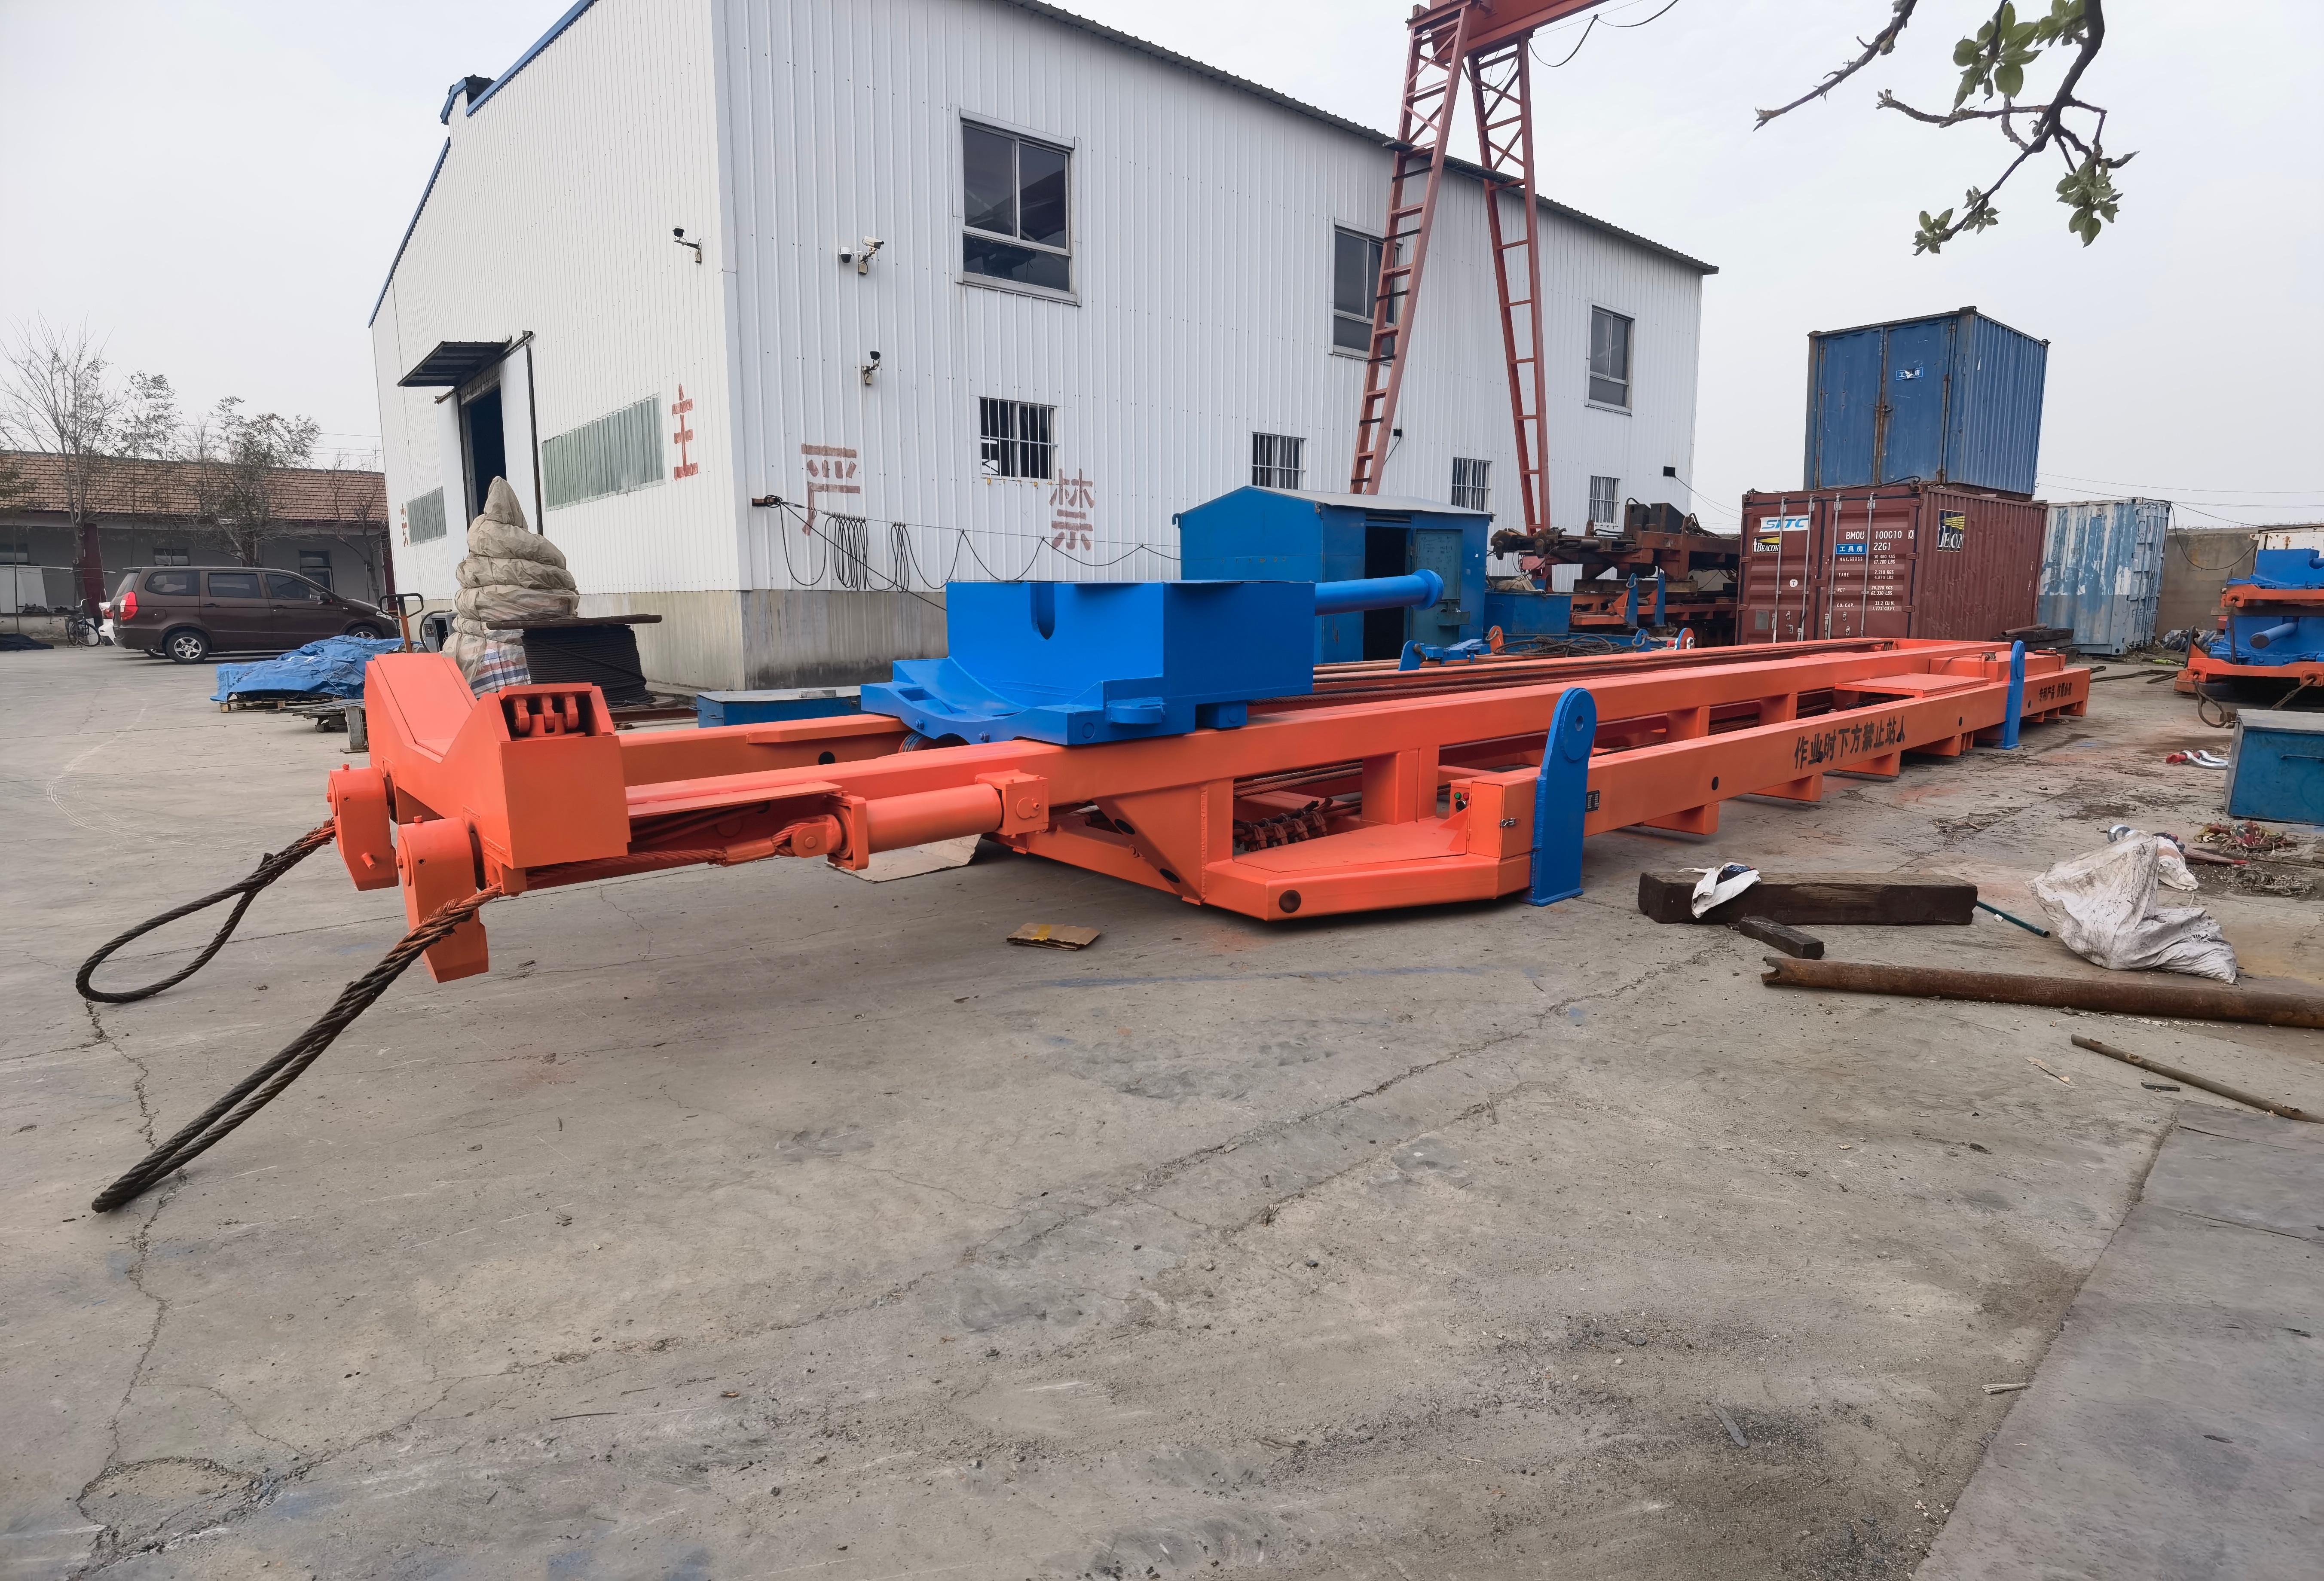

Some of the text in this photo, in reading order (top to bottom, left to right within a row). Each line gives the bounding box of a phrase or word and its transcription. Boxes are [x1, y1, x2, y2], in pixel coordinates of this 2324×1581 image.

[1899, 369, 1920, 378] 工房
[801, 443, 1095, 551] 严 禁
[1845, 531, 1865, 540] BMOU
[1908, 530, 1914, 539] 0
[1757, 542, 1780, 552] BEACON
[1873, 542, 1891, 551] 22G1
[1794, 715, 1905, 769] 作业时下方禁止站人
